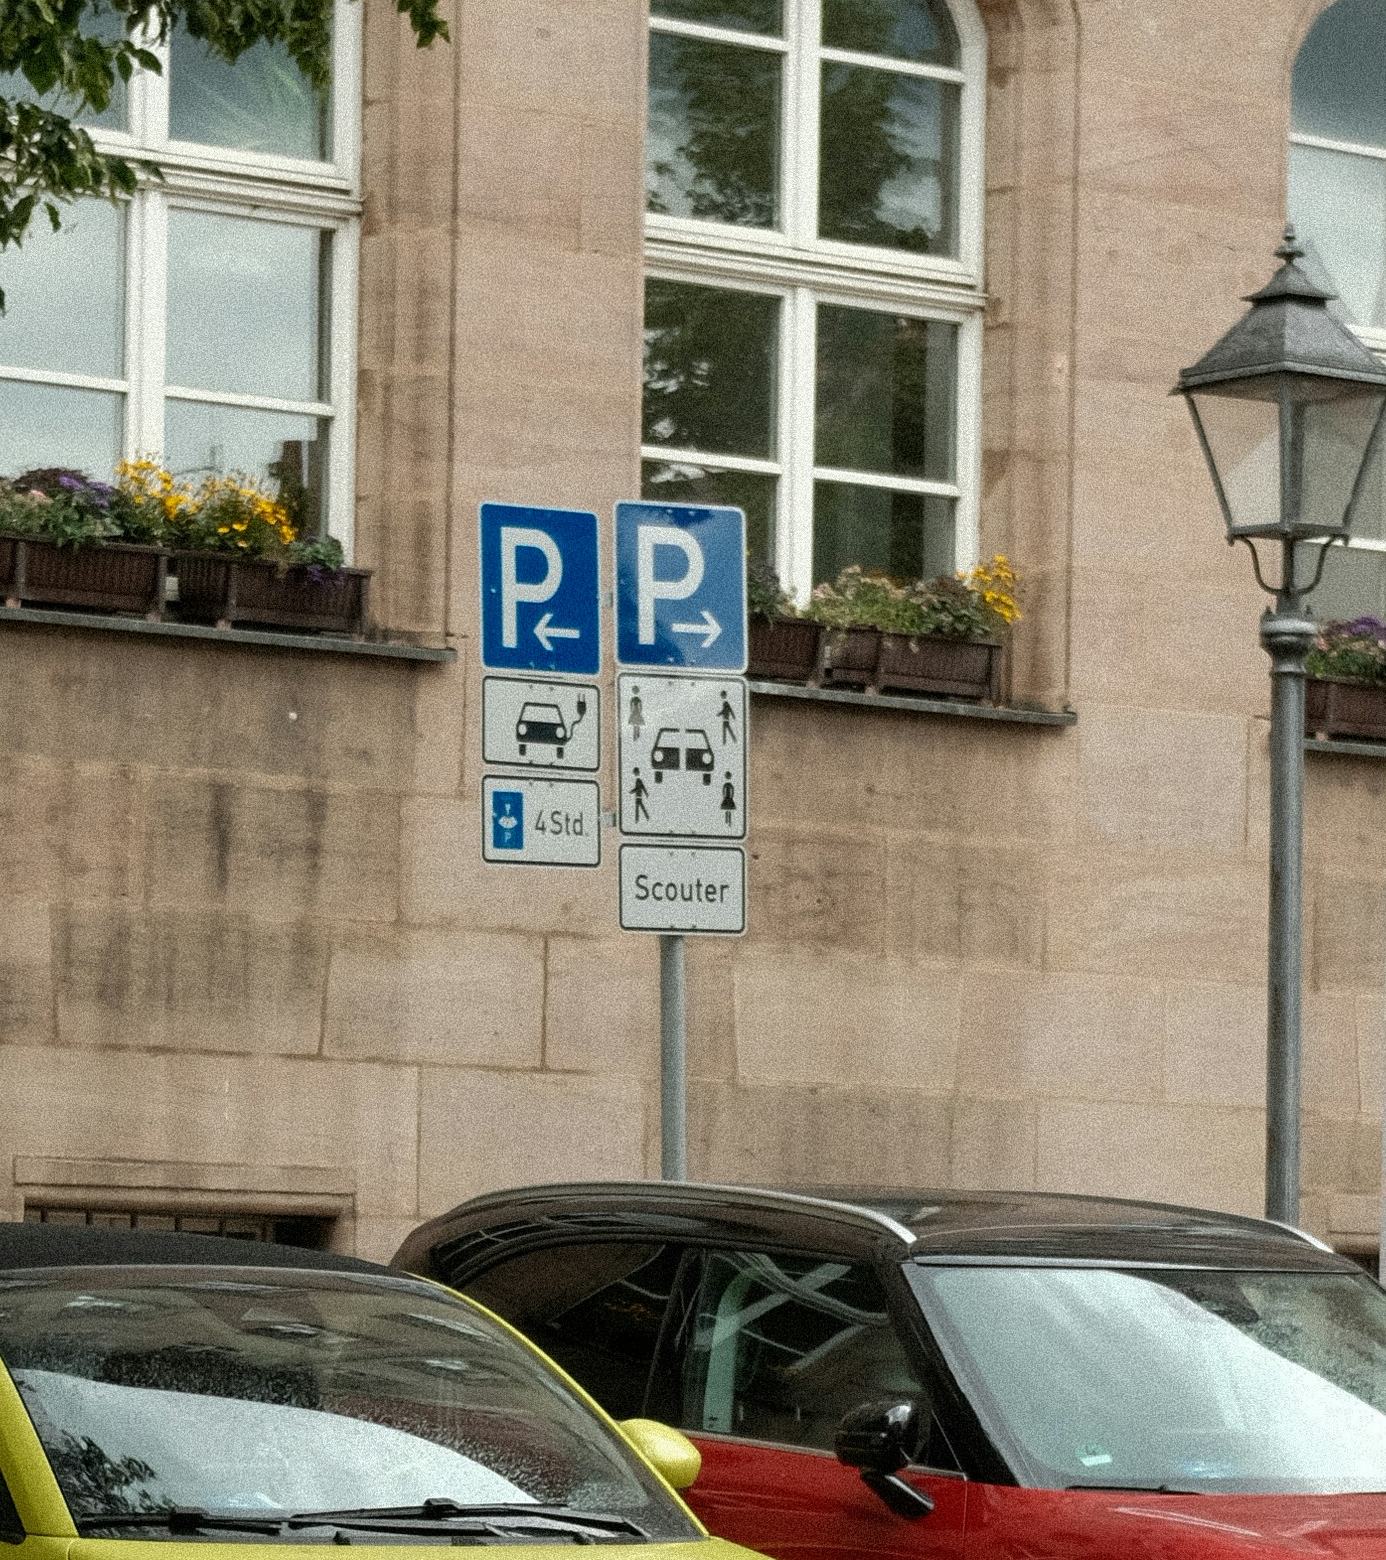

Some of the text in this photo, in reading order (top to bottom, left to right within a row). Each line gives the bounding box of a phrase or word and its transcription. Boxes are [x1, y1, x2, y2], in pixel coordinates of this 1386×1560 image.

[500, 526, 563, 649] P
[636, 525, 705, 645] P
[635, 874, 730, 903] Scouter
